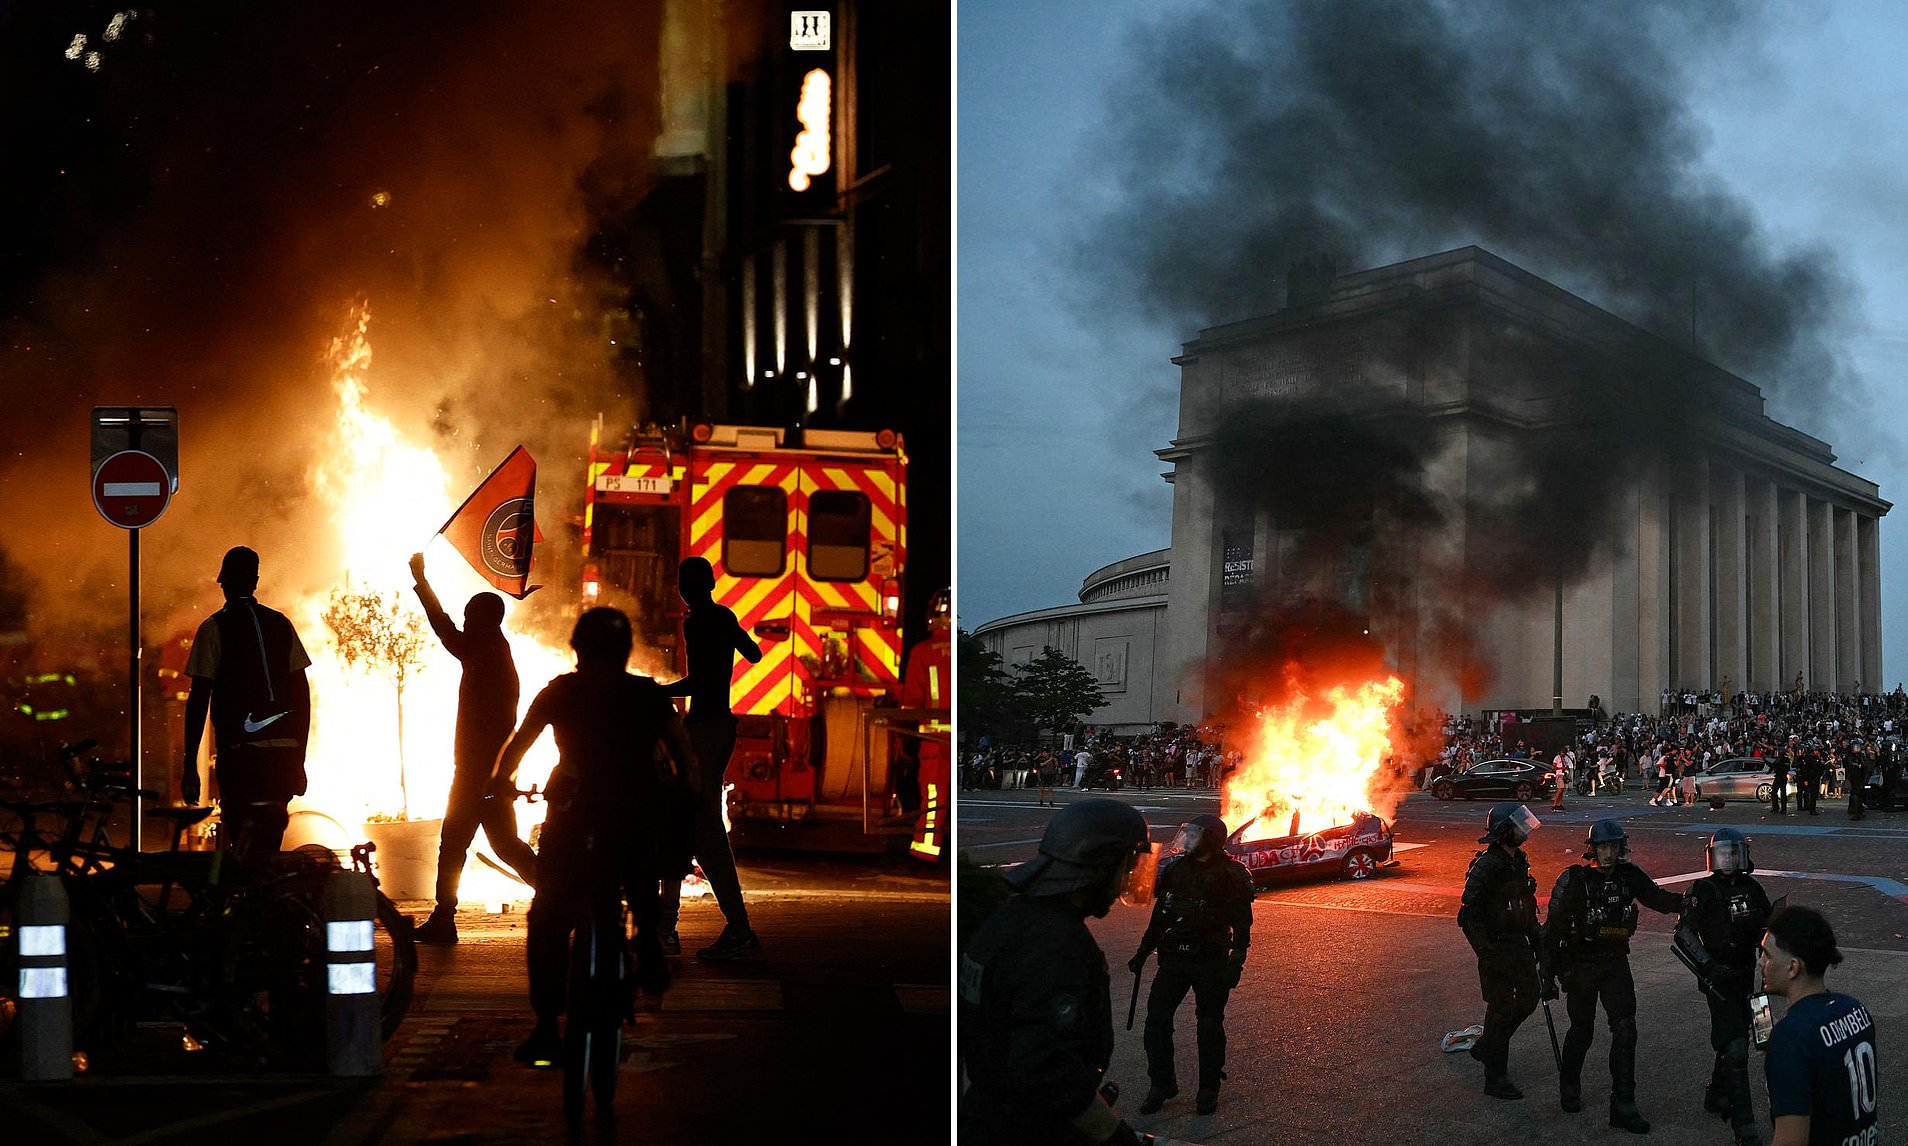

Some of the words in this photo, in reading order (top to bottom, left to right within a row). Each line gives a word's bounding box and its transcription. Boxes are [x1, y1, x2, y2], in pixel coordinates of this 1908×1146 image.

[606, 476, 621, 490] PS
[637, 479, 656, 491] 171
[1843, 1040, 1876, 1120] 10
